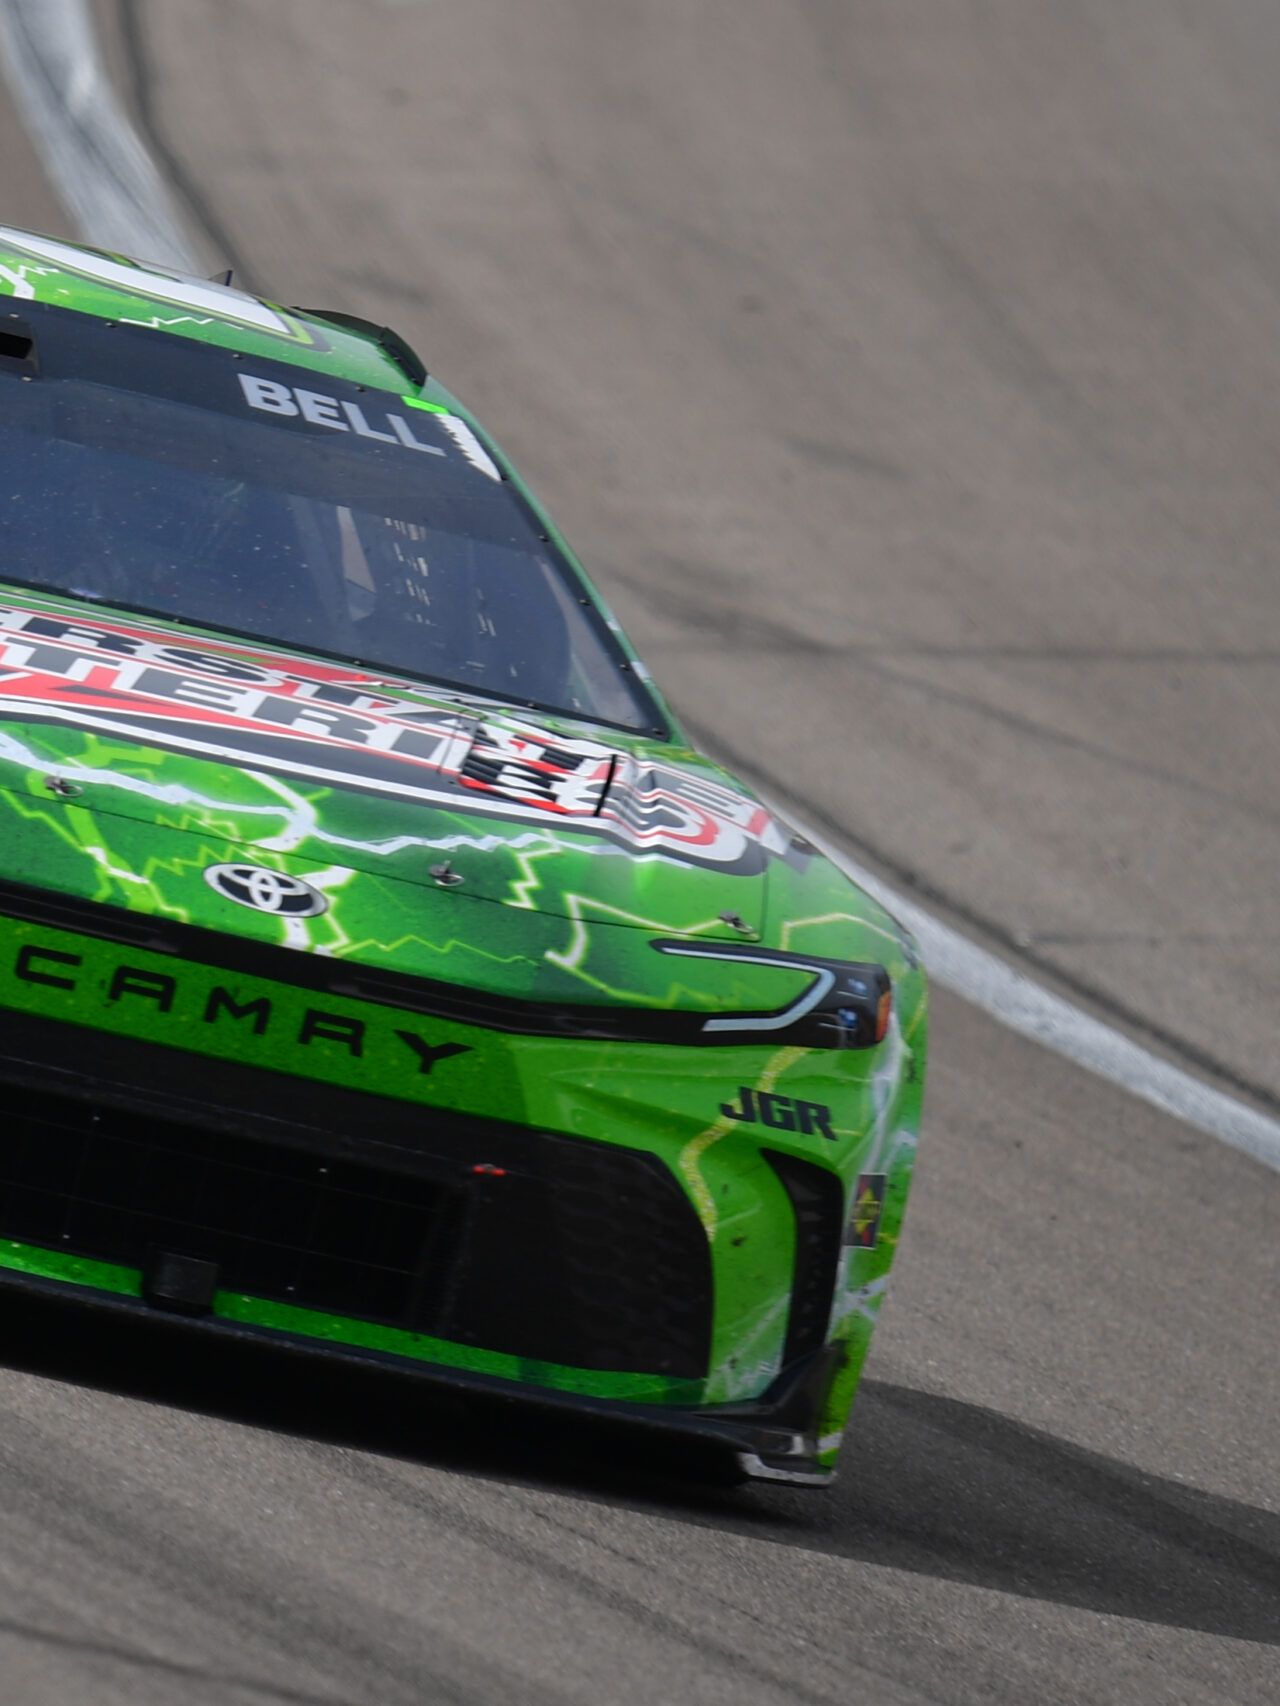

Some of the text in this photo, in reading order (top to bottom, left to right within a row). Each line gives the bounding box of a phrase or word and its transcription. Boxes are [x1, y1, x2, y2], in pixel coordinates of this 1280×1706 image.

[236, 372, 448, 458] BELL
[14, 944, 474, 1075] CAMRY
[718, 1086, 838, 1141] JGR
